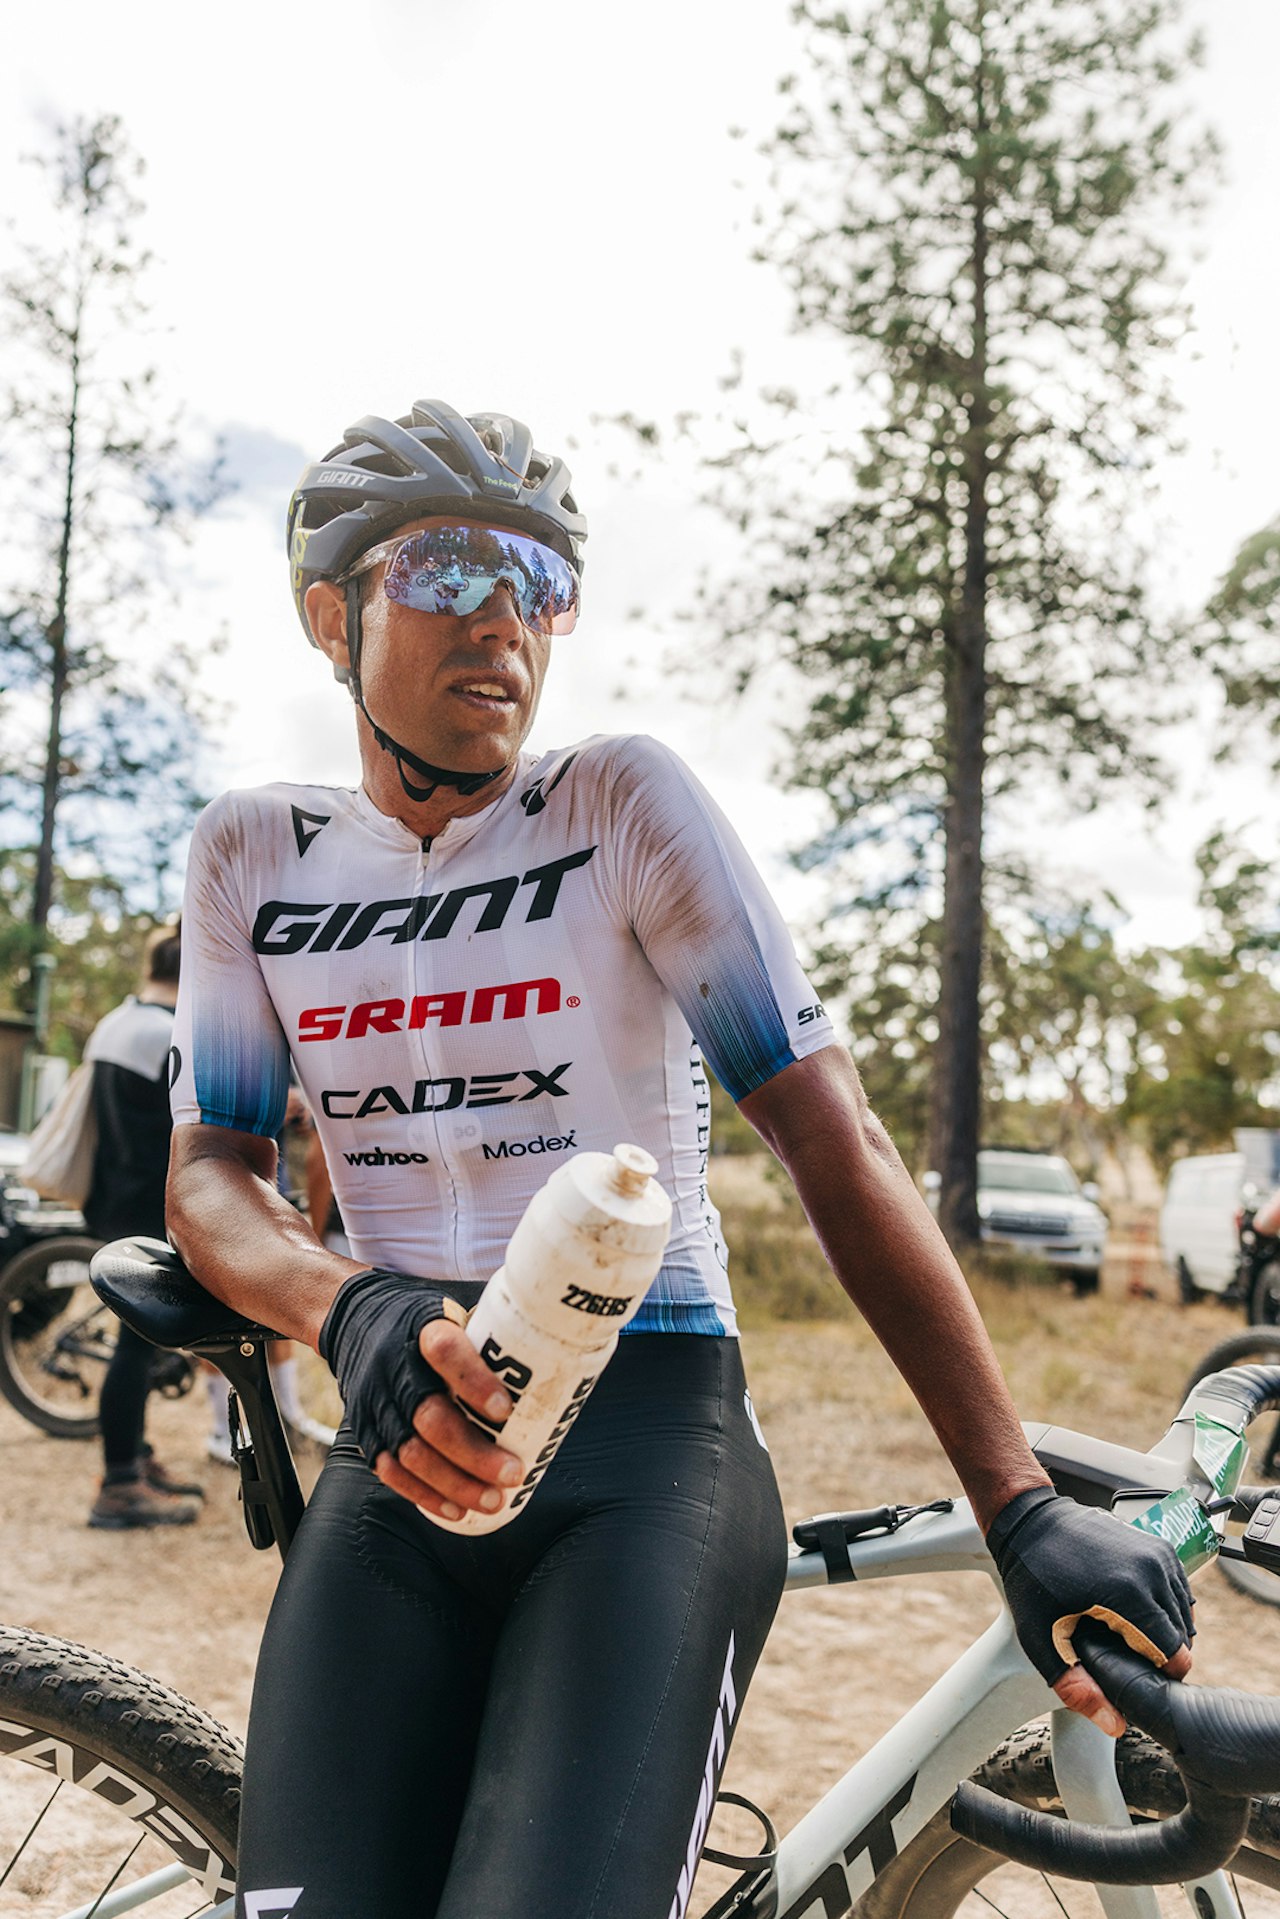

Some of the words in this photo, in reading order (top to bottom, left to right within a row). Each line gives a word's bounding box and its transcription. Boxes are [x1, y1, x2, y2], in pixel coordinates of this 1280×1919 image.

[317, 471, 376, 487] GIANT
[252, 845, 598, 955] GIANT
[321, 1061, 573, 1119] CADEX
[343, 1147, 429, 1167] wahoo
[482, 1130, 578, 1160] Modex
[561, 1284, 636, 1316] 226ERS
